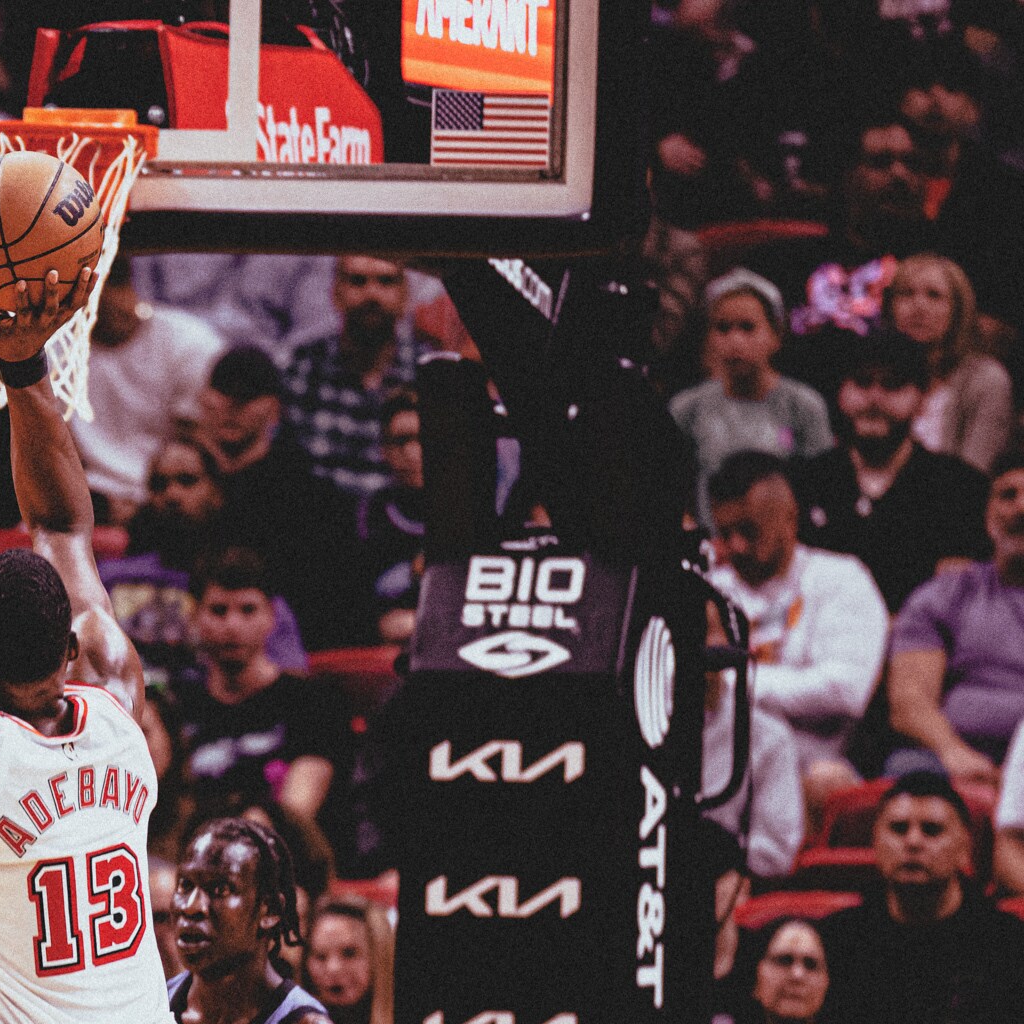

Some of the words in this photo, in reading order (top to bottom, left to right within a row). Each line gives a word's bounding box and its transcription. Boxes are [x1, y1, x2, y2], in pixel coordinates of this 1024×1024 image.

[465, 555, 587, 604] BIO
[26, 842, 147, 978] 13
[636, 764, 667, 1009] AT&T
